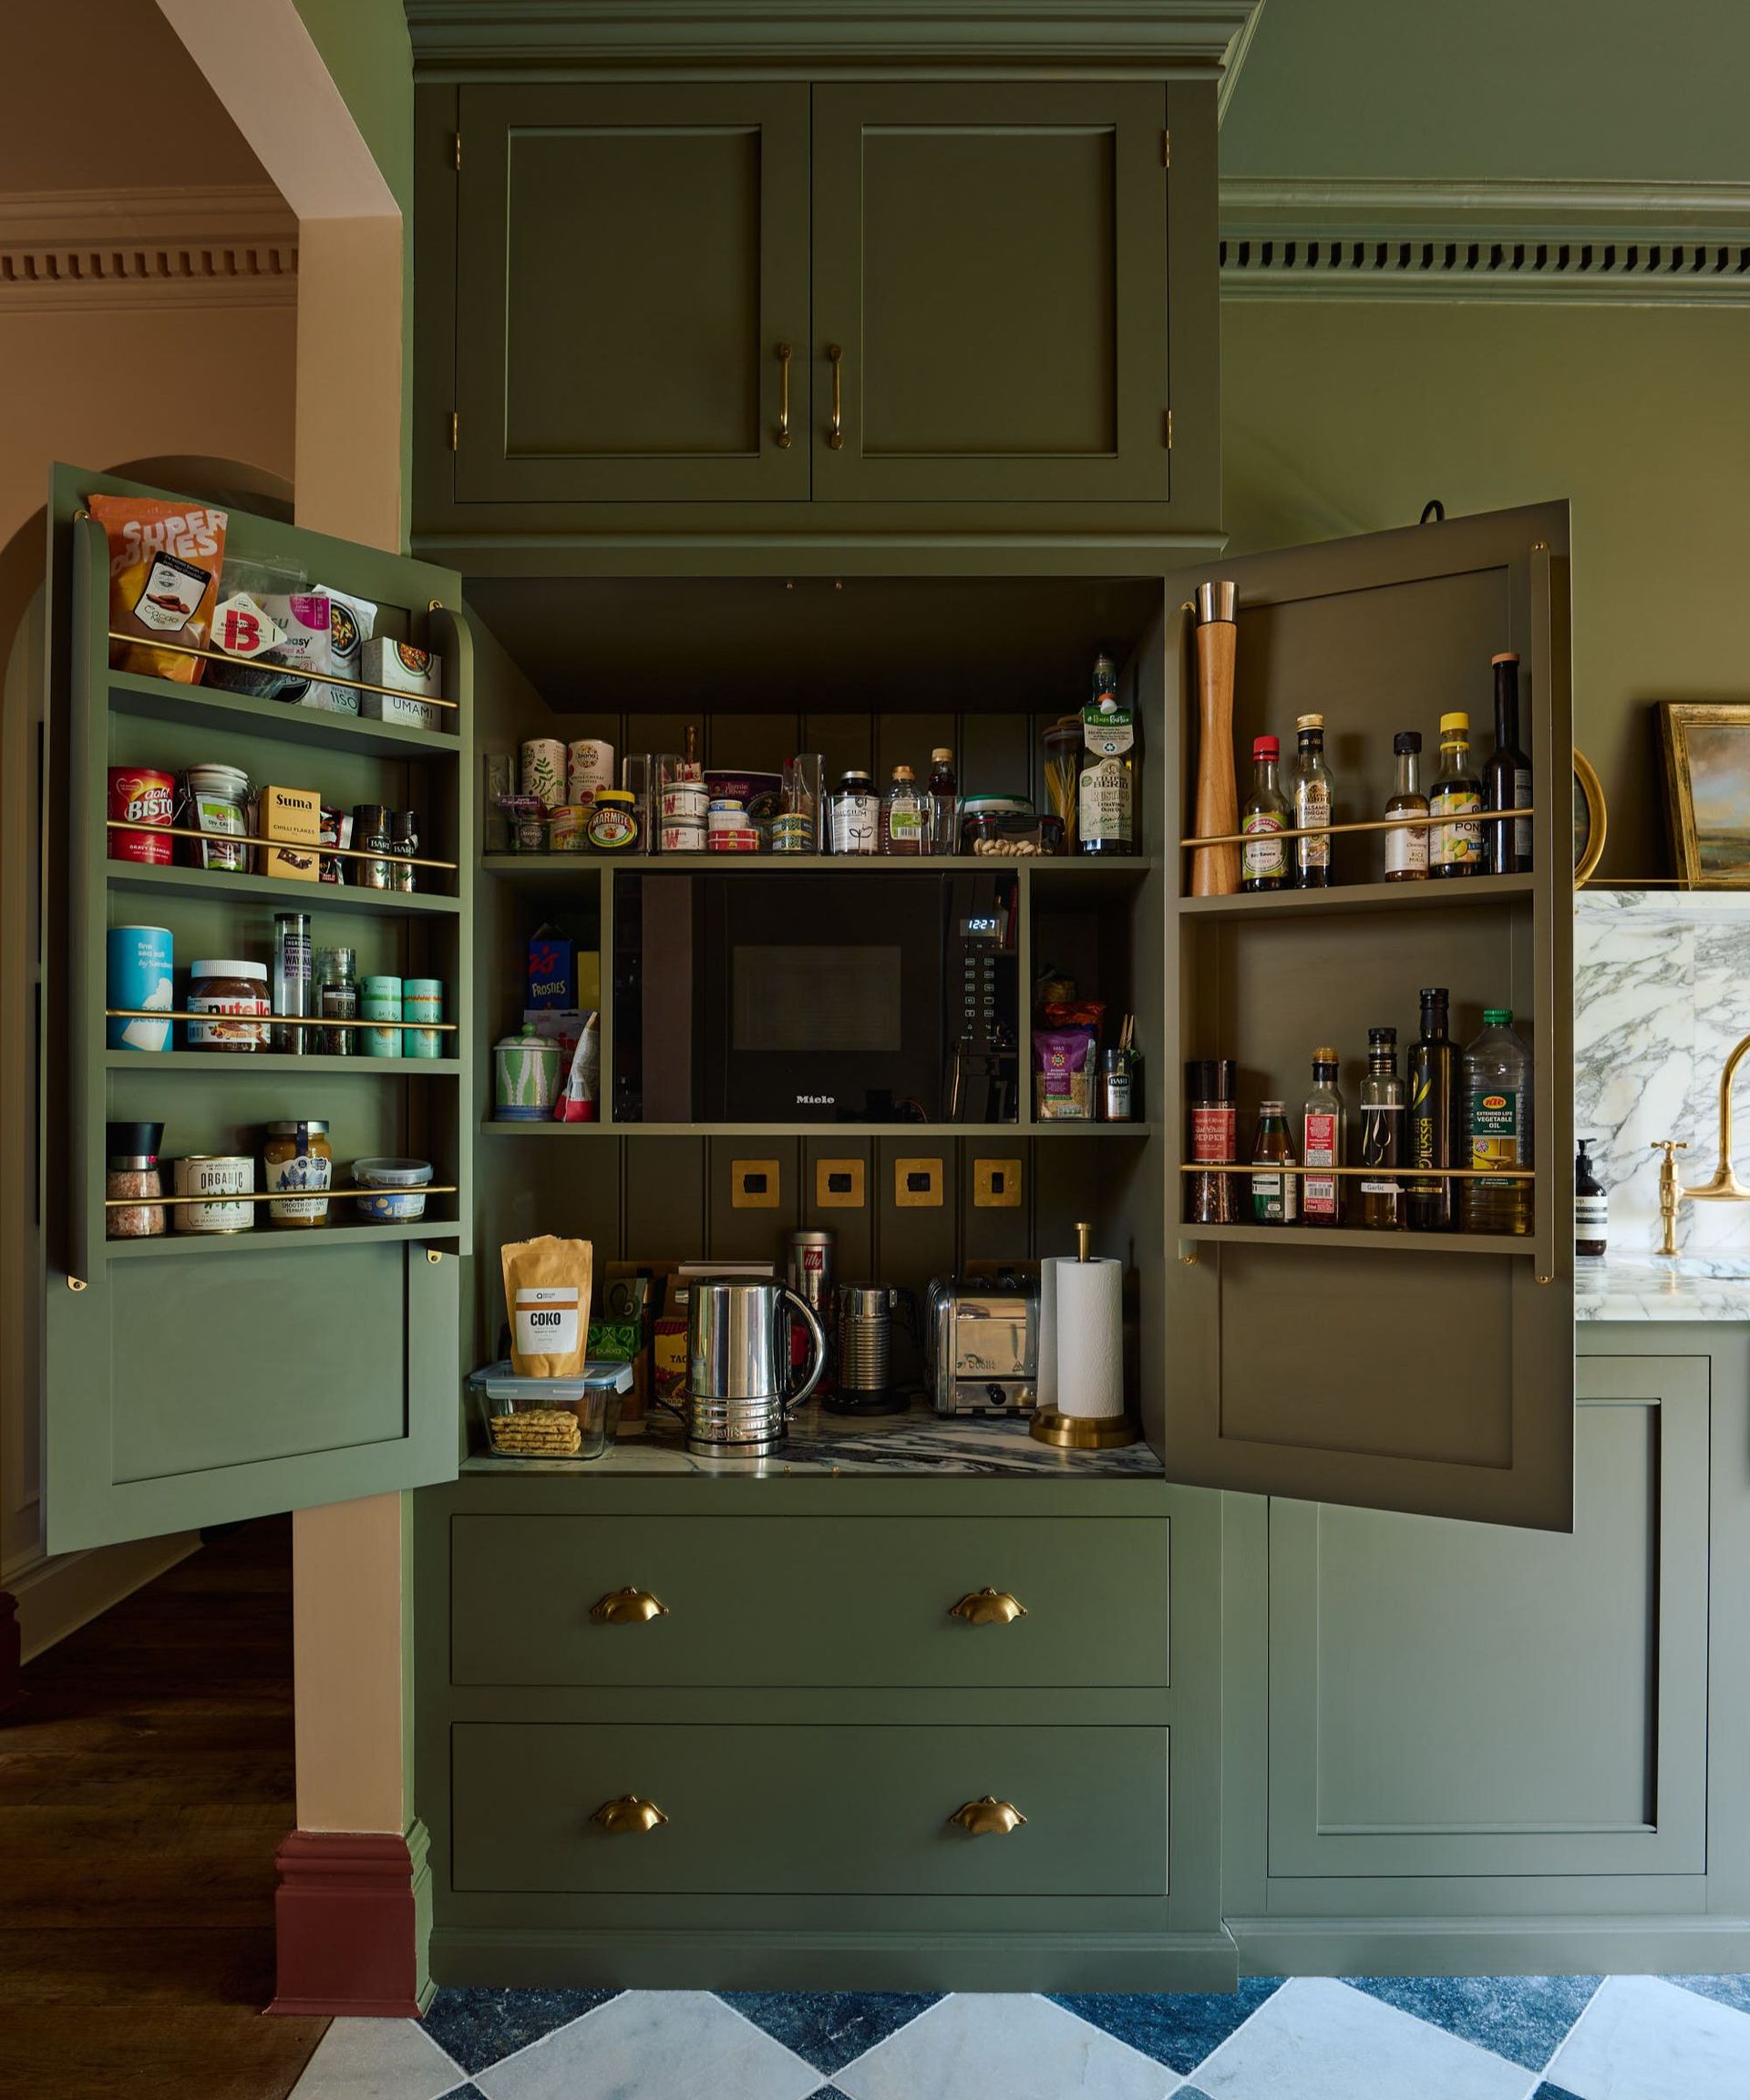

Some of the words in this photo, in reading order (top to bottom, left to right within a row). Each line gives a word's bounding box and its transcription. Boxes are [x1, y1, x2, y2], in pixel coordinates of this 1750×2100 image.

[123, 510, 228, 549] SUPER
[145, 605, 180, 623] Cacao
[225, 610, 261, 652] B
[394, 697, 433, 720] UMAMI
[145, 788, 170, 800] aah!
[276, 794, 313, 810] Suma
[128, 798, 173, 822] BISTO
[273, 824, 293, 832] CHILLI
[592, 811, 629, 828] MARMITE
[532, 982, 567, 999] FROSTIES
[796, 1095, 837, 1105] Miele
[1476, 1116, 1513, 1124] VEGETABLE
[201, 1171, 243, 1189] ORGANIC
[805, 1252, 823, 1269] illy
[530, 1312, 561, 1326] COKO
